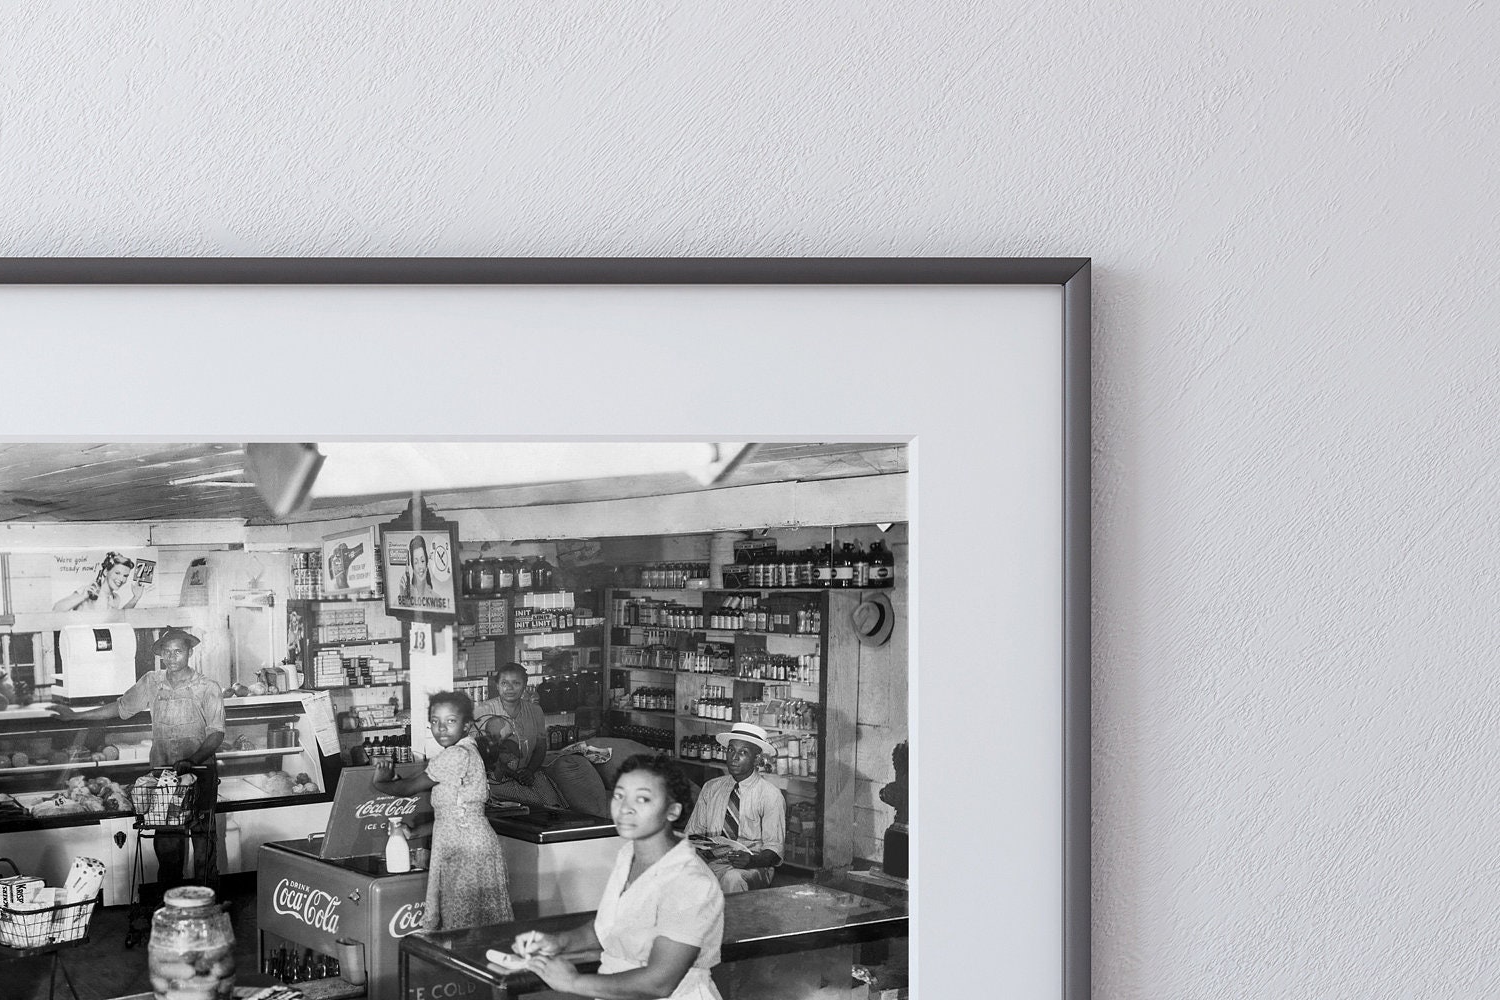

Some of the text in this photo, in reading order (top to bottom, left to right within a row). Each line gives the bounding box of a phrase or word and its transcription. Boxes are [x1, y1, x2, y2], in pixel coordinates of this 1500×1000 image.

[514, 621, 530, 629] INIT
[364, 823, 378, 831] ICE
[290, 880, 311, 893] DRINK
[431, 982, 477, 999] COLD
